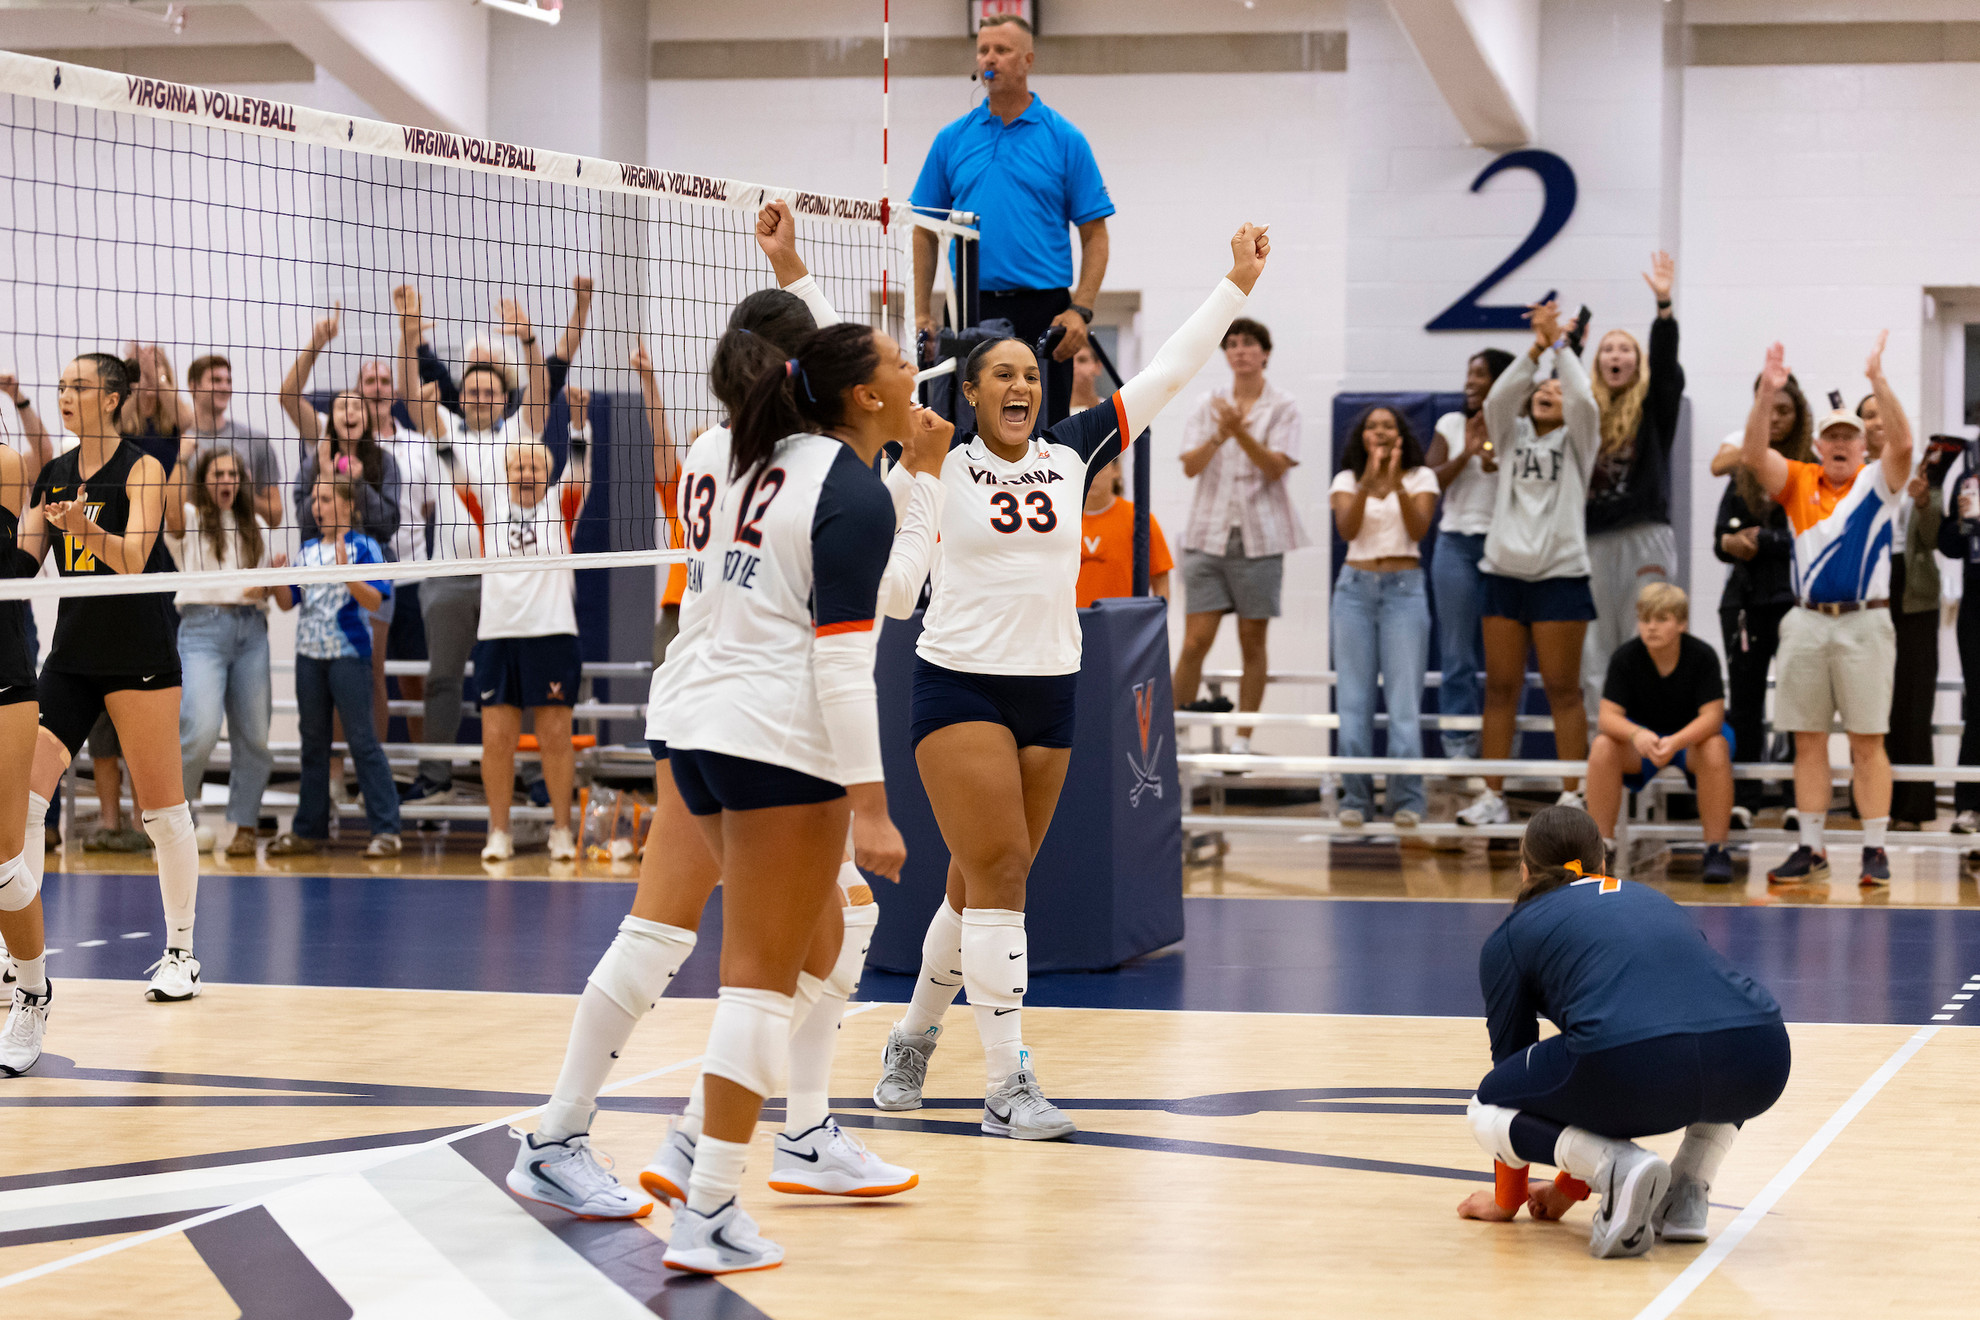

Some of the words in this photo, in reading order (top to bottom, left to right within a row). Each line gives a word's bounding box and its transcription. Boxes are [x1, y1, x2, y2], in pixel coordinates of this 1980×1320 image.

[126, 75, 198, 115] VIRGINIA
[201, 89, 297, 133] VOLLEYBALL
[402, 126, 460, 160] VIRGINIA
[461, 136, 537, 172] VOLLEYBALL
[619, 163, 666, 192] VIRGINIA
[667, 171, 727, 202] VOLLEYBALL
[795, 191, 831, 216] VIRGINIA
[1424, 149, 1579, 331] 2
[683, 472, 716, 552] 13
[733, 467, 786, 549] 12
[990, 490, 1058, 534] 33
[63, 532, 95, 572] 12
